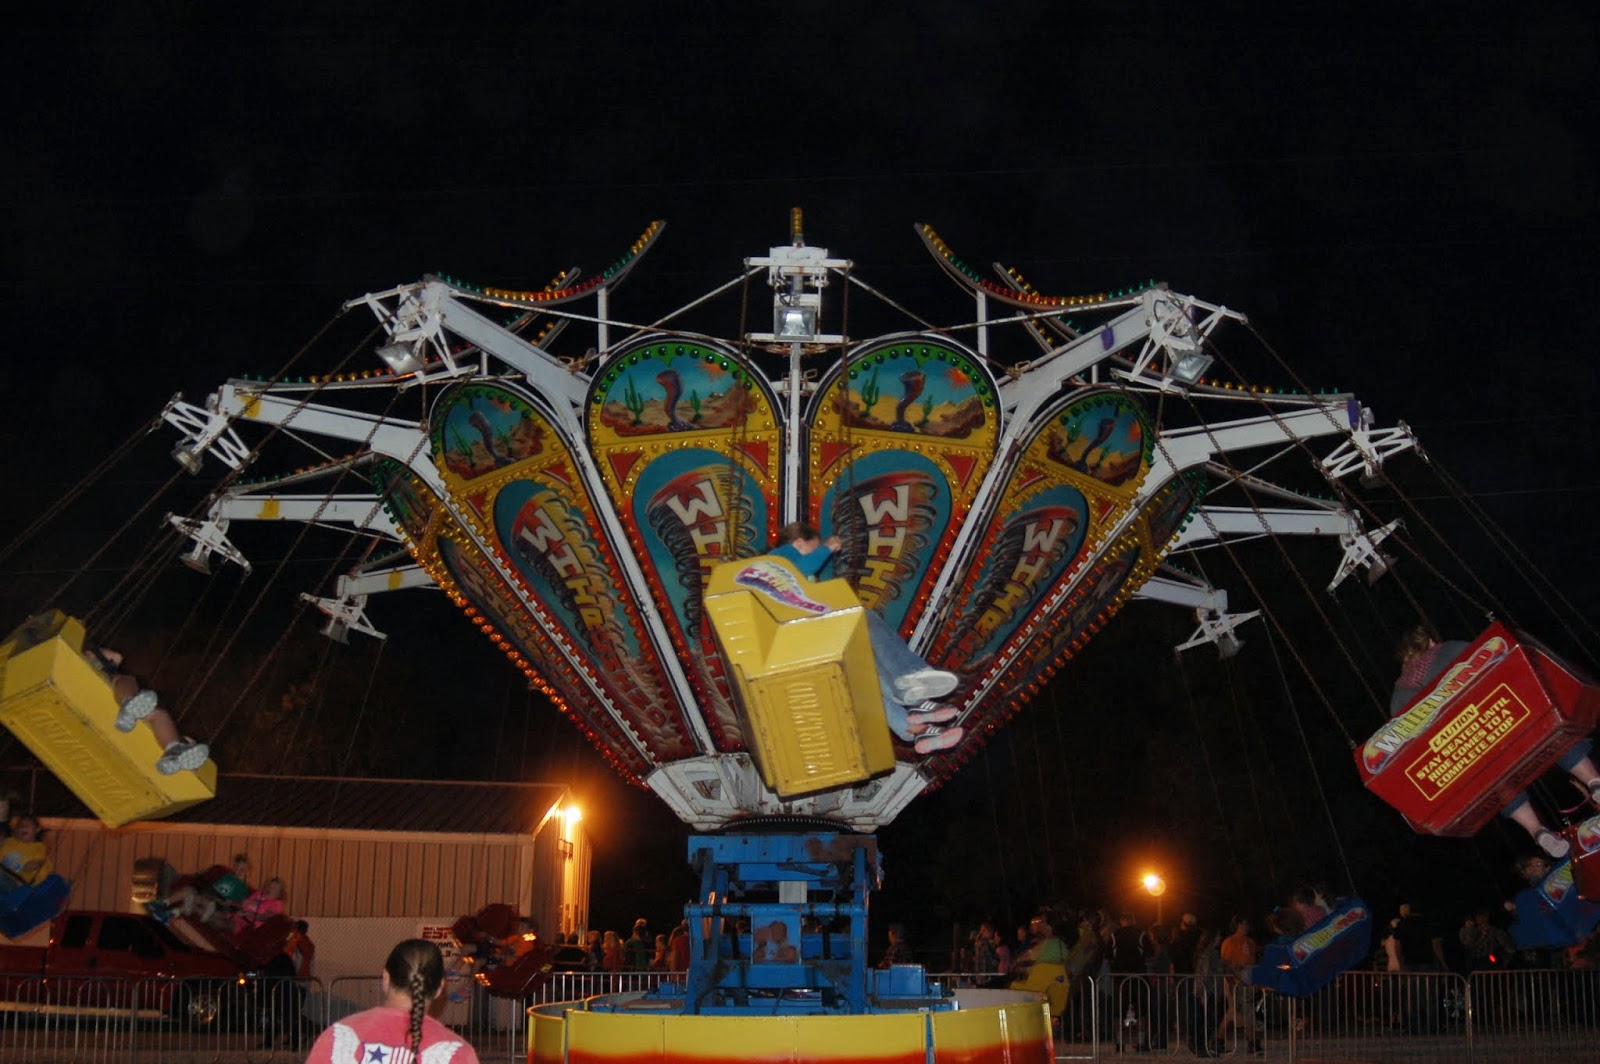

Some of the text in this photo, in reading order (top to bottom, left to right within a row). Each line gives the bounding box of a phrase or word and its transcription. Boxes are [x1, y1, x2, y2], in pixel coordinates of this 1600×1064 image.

[1374, 648, 1494, 754] WHIRLWIND
[1432, 706, 1477, 749] CAUTION
[1416, 696, 1510, 780] STAY SEATED UNTIL
[1428, 709, 1512, 782] RIDE COMES TO A
[1436, 741, 1489, 788] COMPLETE
[1487, 716, 1515, 744] STOP
